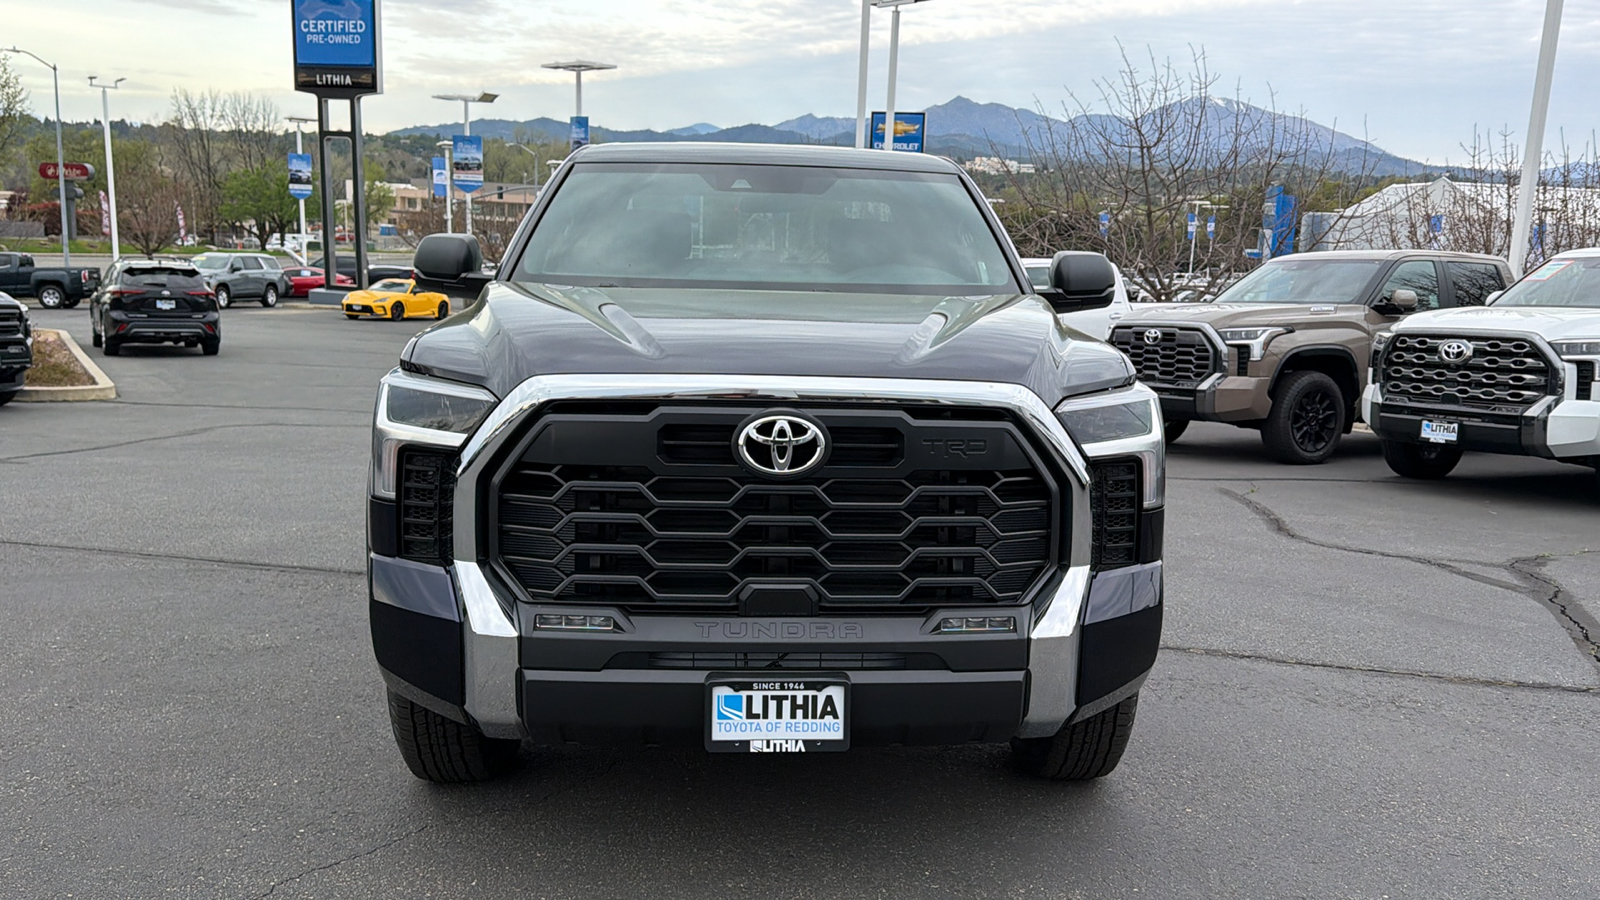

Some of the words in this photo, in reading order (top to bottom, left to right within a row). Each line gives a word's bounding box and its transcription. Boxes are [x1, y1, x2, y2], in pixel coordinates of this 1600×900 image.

[300, 19, 366, 33] CERTIFIED
[306, 34, 361, 44] PRE-OWNED
[316, 74, 352, 86] LITHIA
[1431, 424, 1456, 433] LITHIA
[922, 439, 987, 458] TRD
[694, 622, 863, 639] TUNDRA
[745, 695, 839, 720] LITHIA
[717, 722, 762, 732] TOYOTA
[766, 722, 782, 732] OF
[785, 722, 840, 732] REDDING
[762, 740, 806, 752] LITHIA
